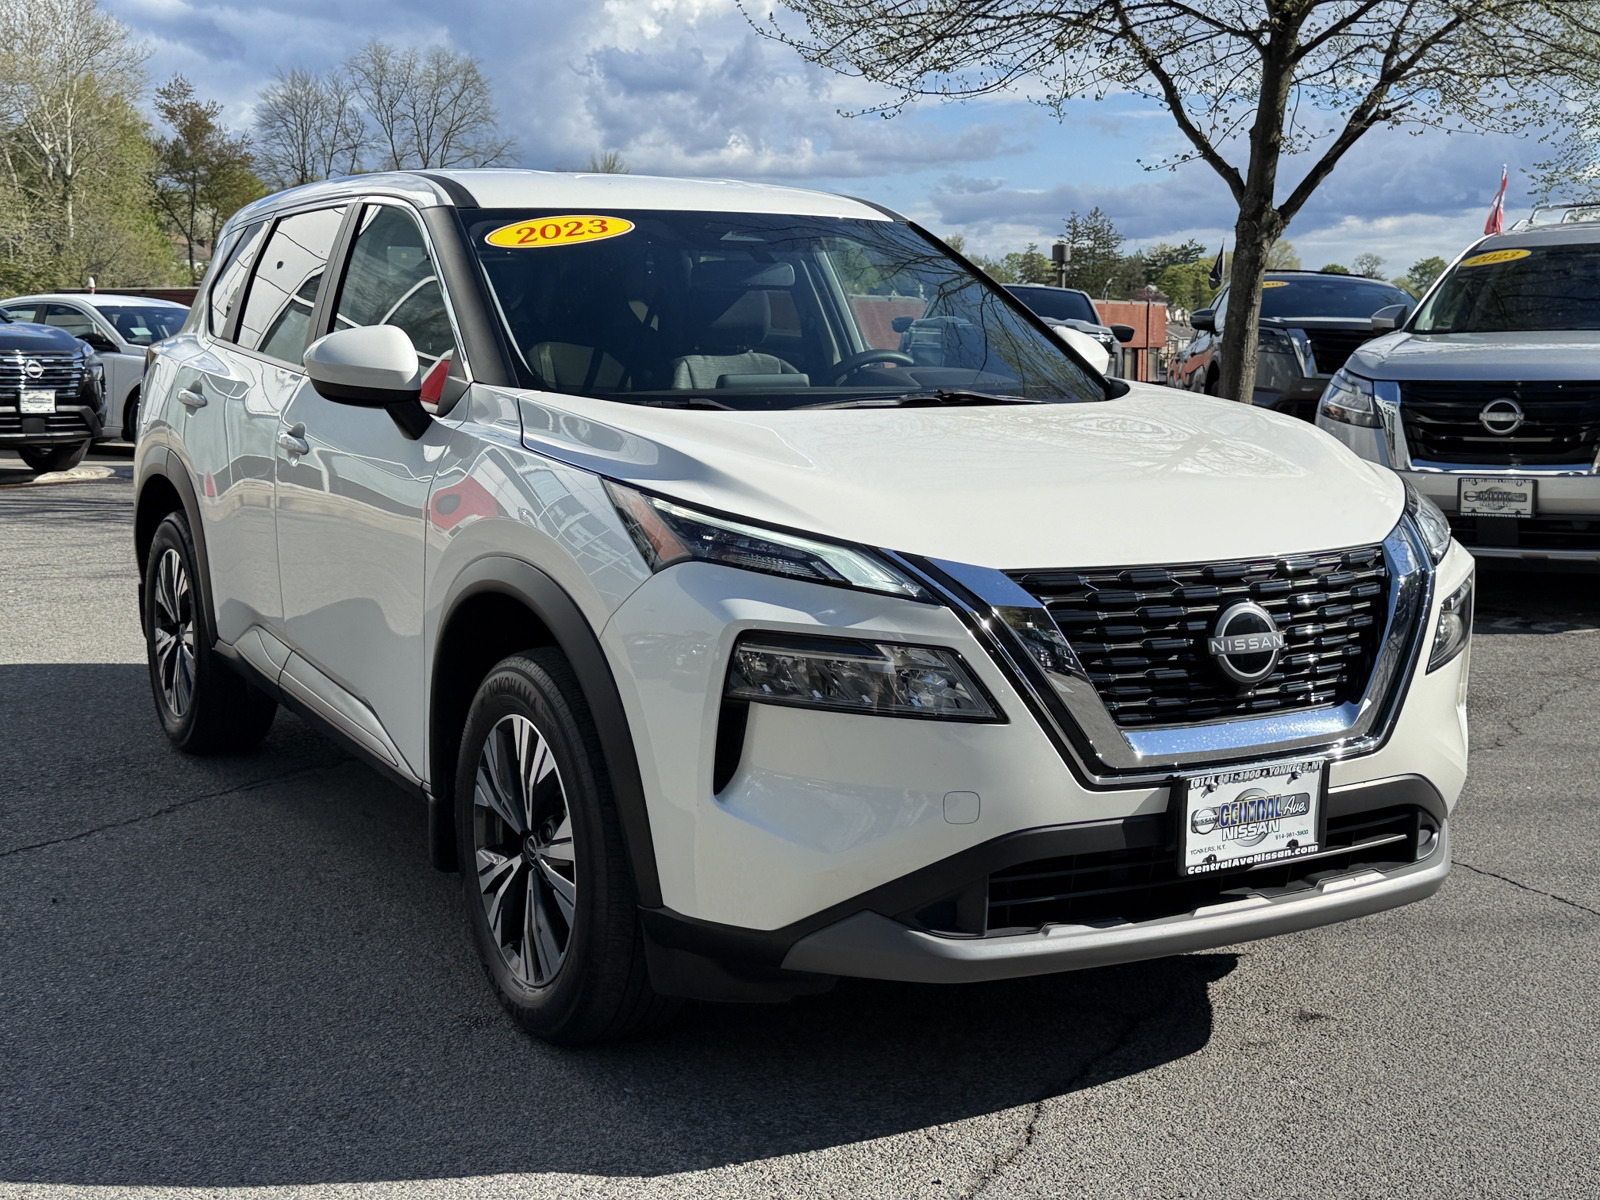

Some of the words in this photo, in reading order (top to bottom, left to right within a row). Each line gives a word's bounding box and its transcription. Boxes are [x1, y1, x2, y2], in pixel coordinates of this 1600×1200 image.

[516, 219, 608, 244] 2023
[1211, 634, 1283, 653] NISSAN
[487, 676, 537, 715] YOKOHAMA
[1220, 794, 1282, 827] CENTRAL
[1283, 796, 1307, 815] Ave.
[1222, 819, 1280, 841] NISSAN
